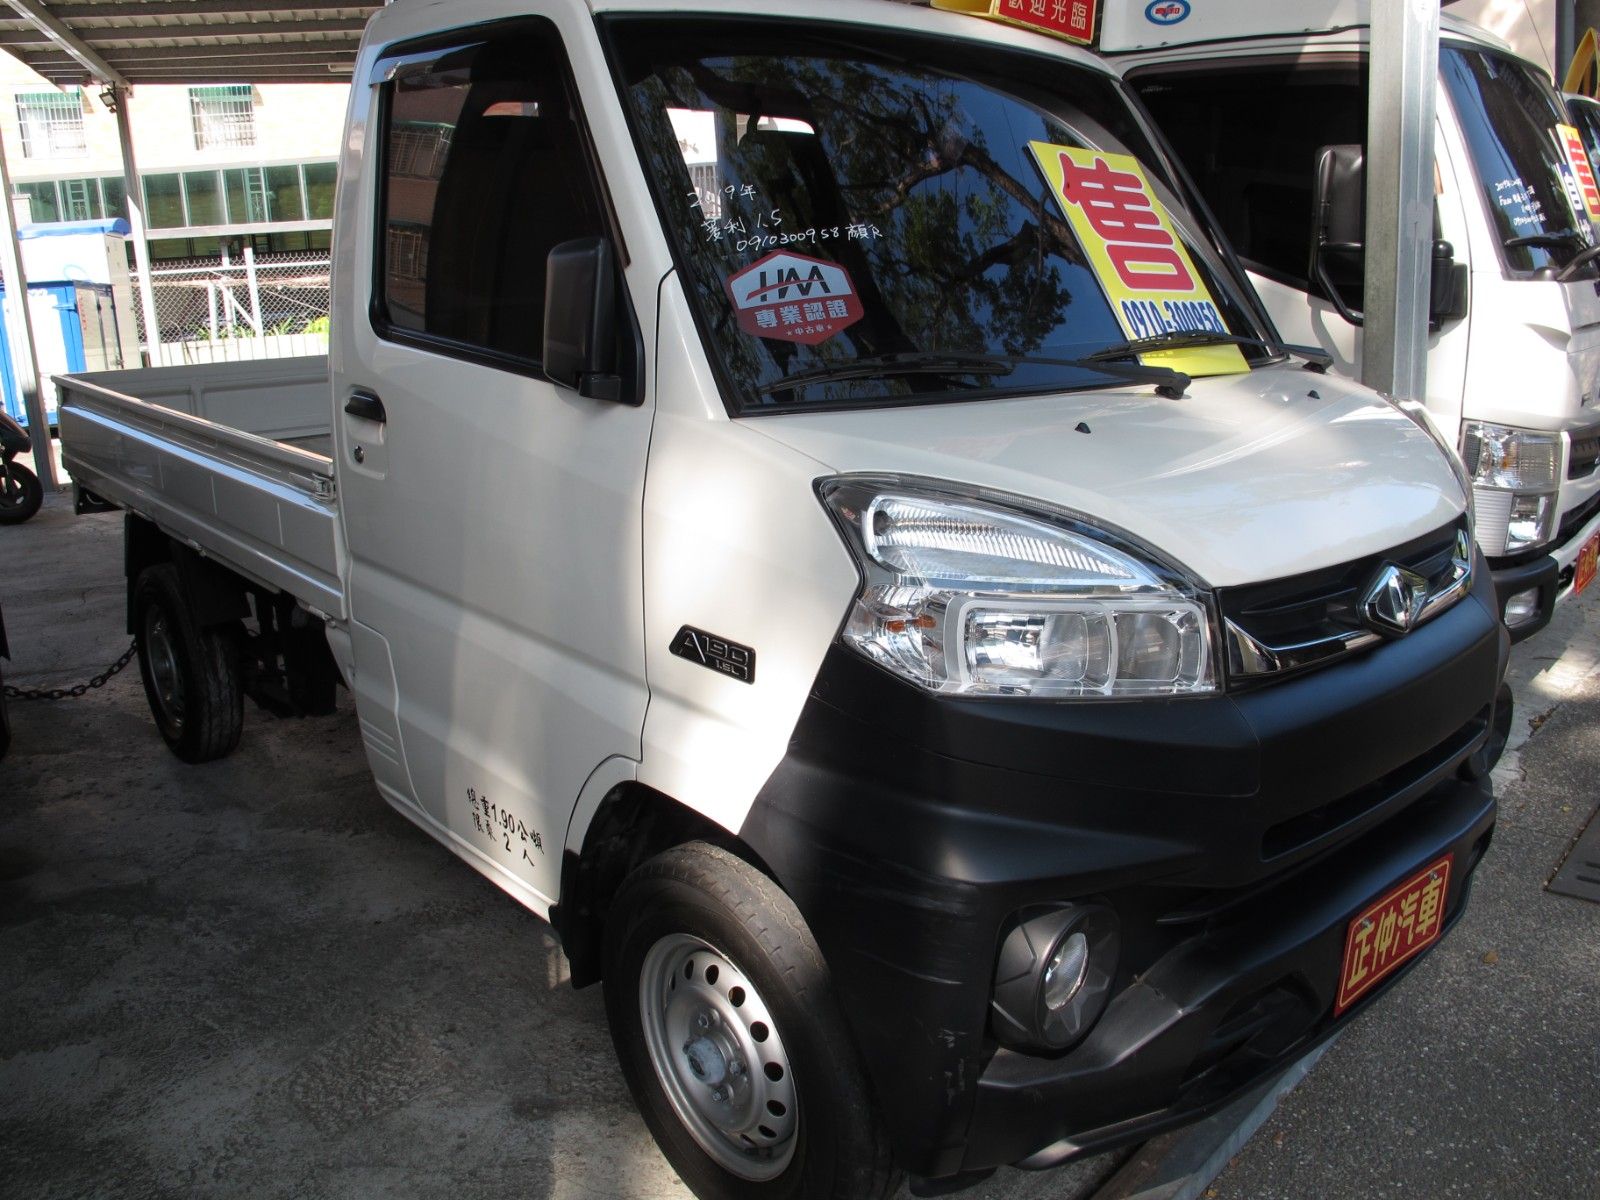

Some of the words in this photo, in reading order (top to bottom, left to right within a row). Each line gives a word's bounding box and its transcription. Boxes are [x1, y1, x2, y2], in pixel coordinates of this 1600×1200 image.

[757, 208, 782, 229] 1.5
[1058, 151, 1196, 292] 售
[736, 226, 840, 252] 0910300958
[755, 299, 848, 328] 專業認證
[1120, 299, 1225, 339] 0910-300958
